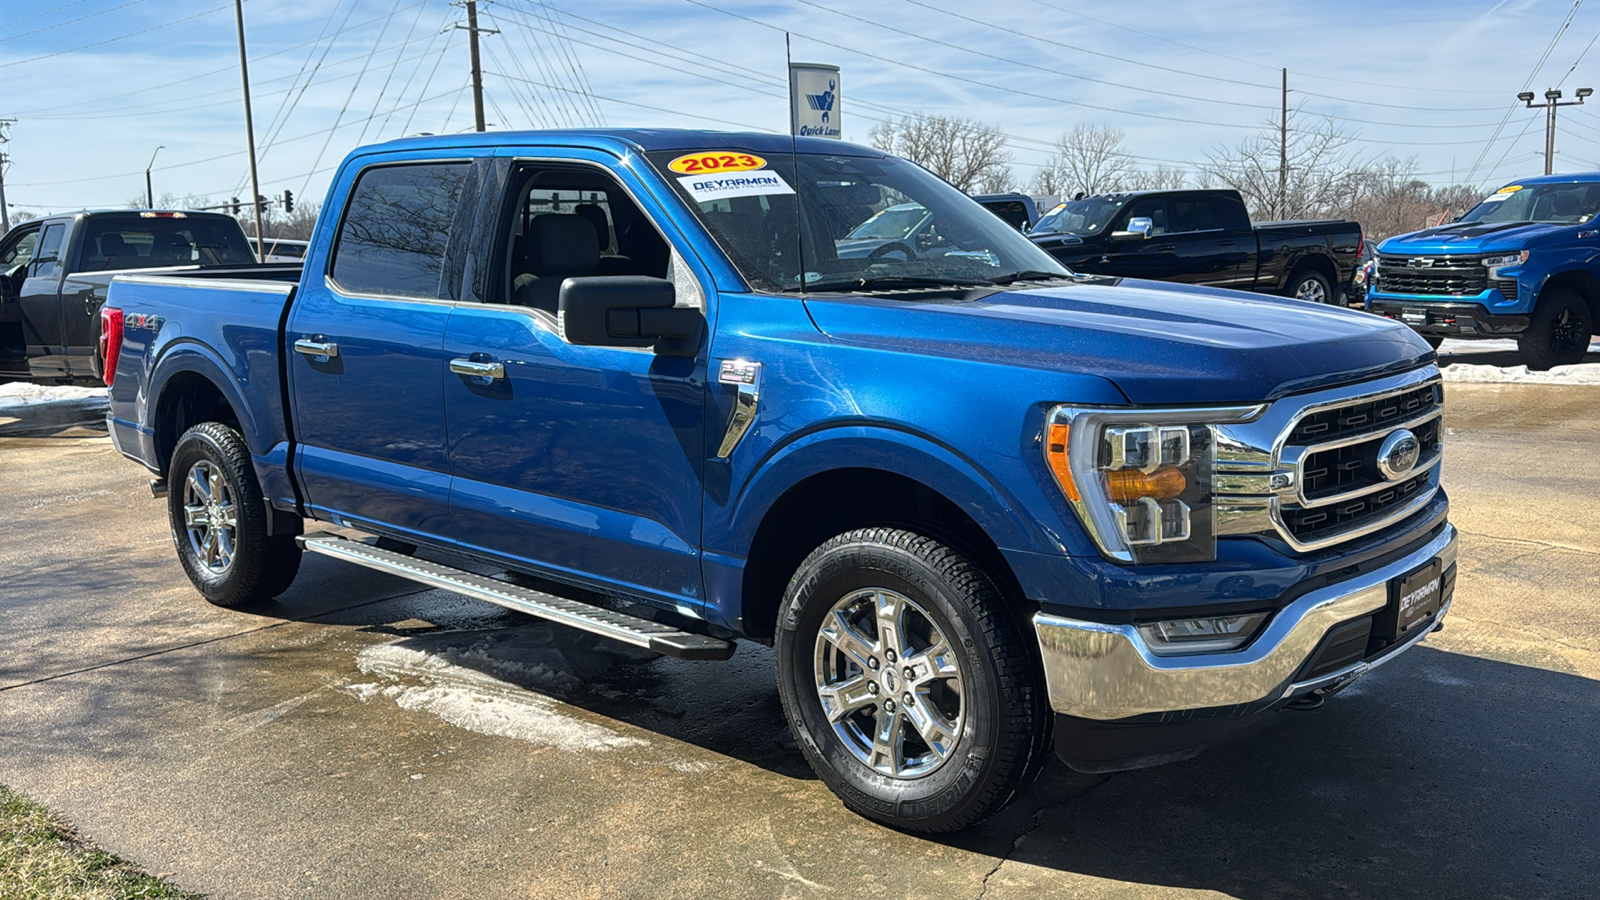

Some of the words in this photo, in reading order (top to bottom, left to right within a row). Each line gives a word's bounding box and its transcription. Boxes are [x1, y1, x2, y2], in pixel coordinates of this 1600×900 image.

[800, 125, 824, 136] Quick
[682, 155, 758, 172] 2023
[693, 177, 778, 191] DEYARMAN
[703, 185, 740, 193] CERTIFIED
[1396, 444, 1415, 467] Ford
[1400, 576, 1440, 613] DEYARMAN
